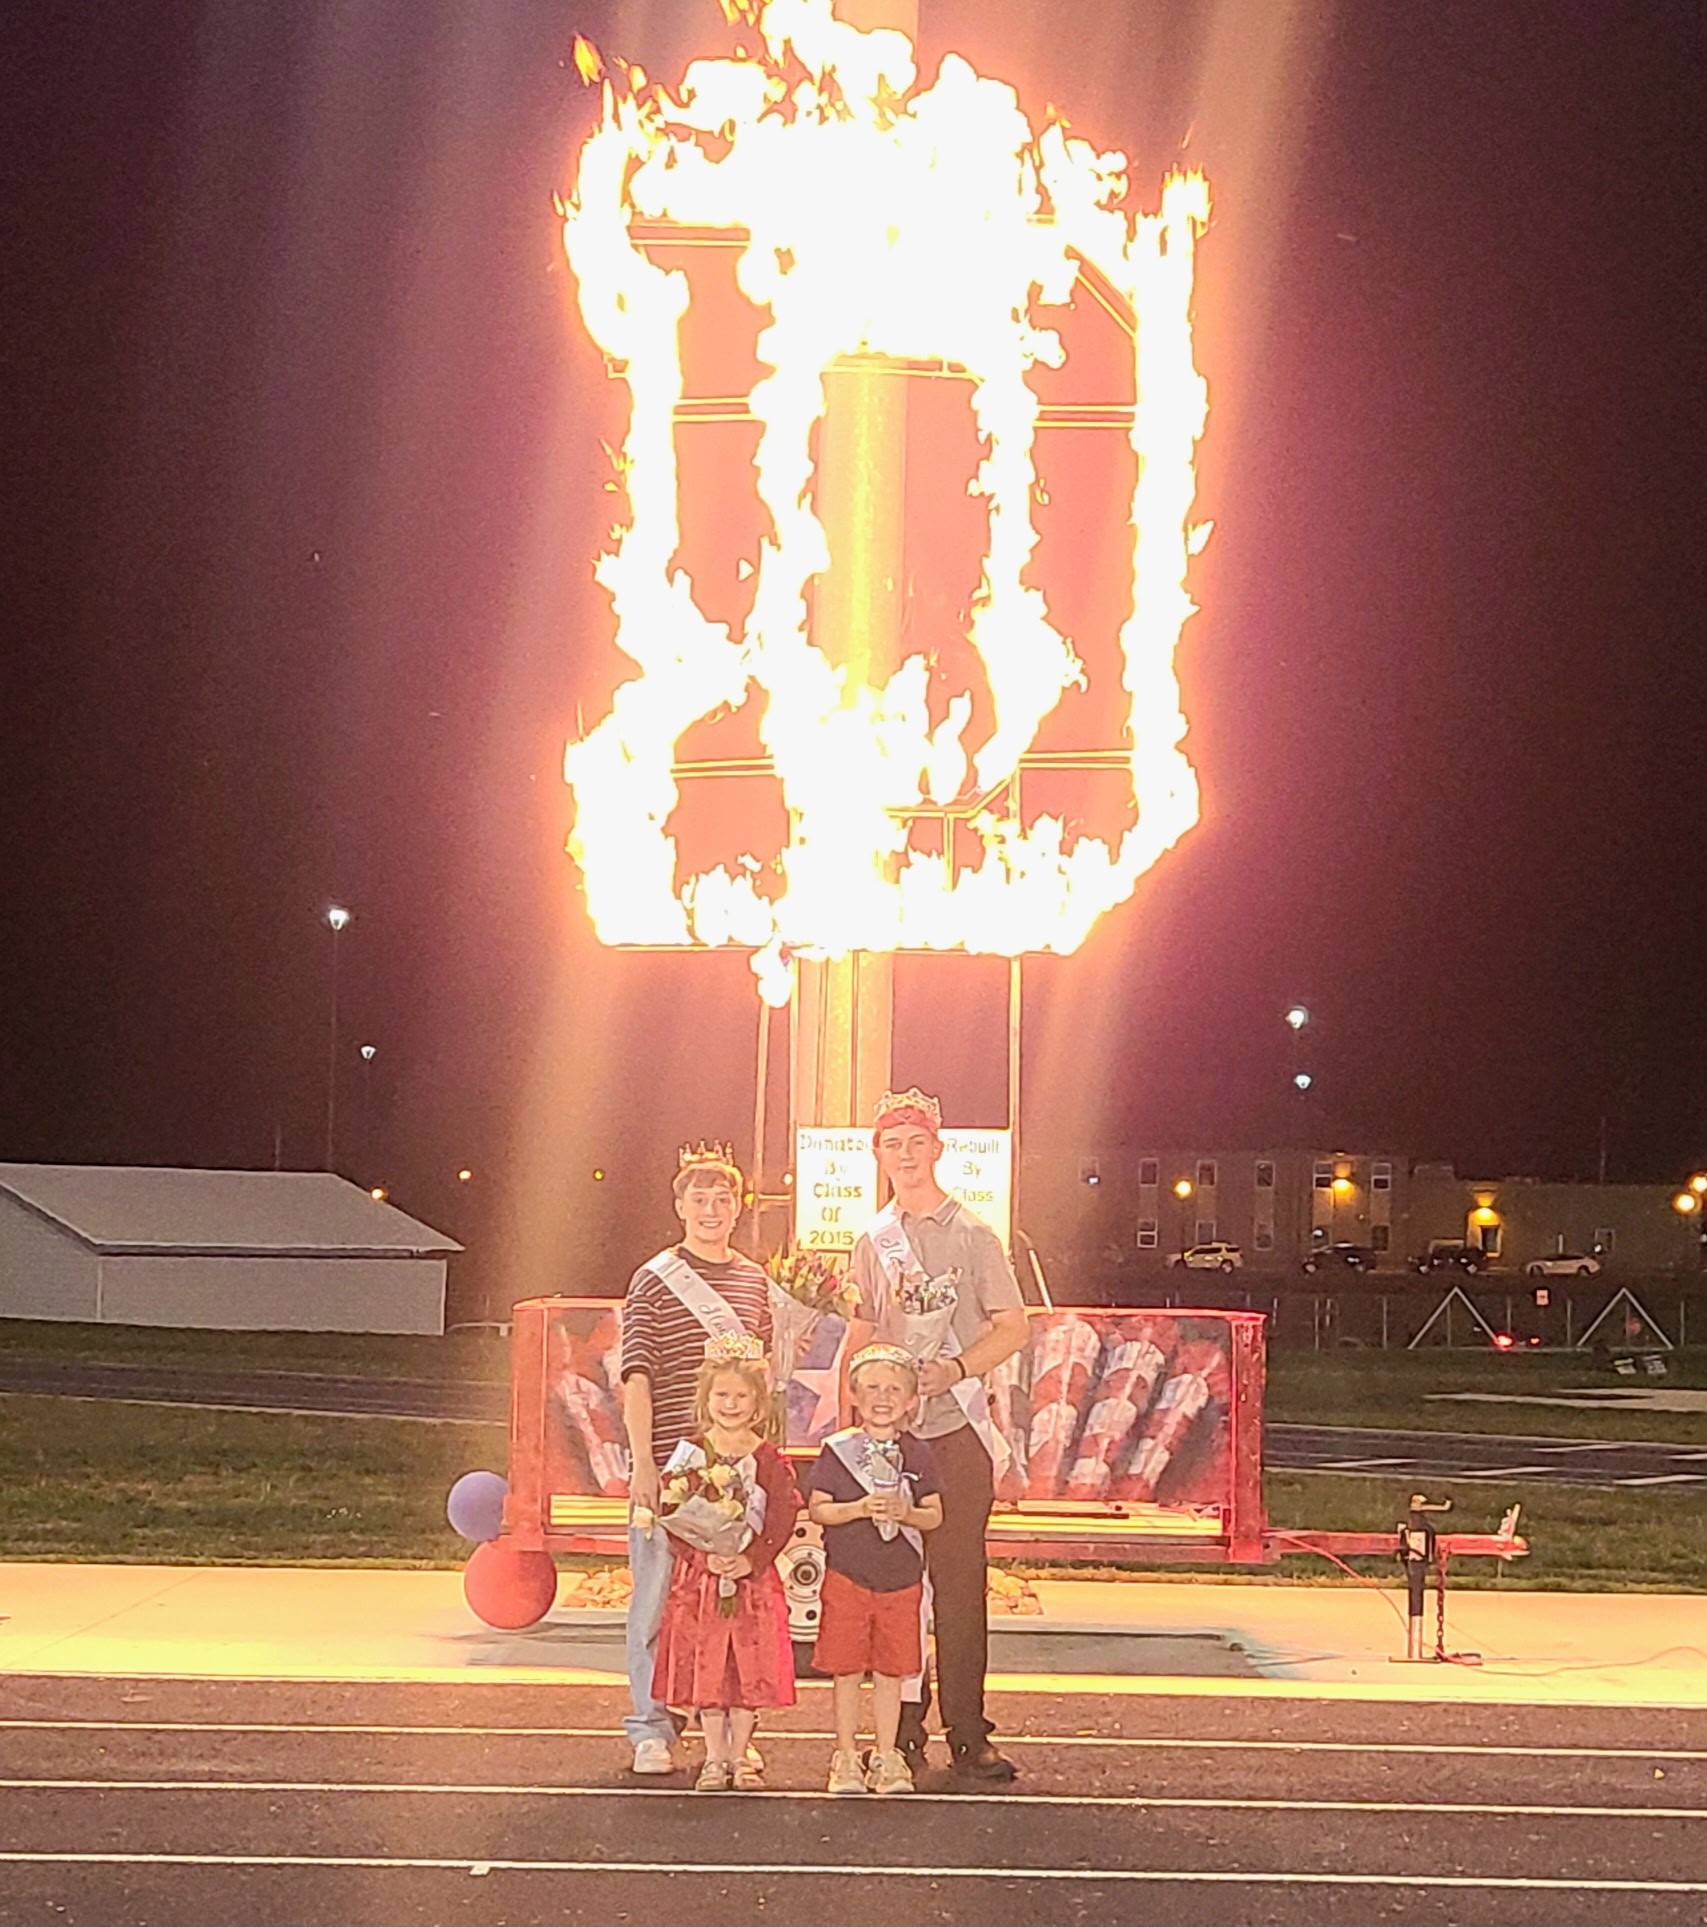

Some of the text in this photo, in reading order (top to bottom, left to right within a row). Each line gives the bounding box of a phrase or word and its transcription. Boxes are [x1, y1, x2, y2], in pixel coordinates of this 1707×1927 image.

[946, 1137, 1000, 1154] Rebuilt
[962, 1160, 981, 1179] By
[813, 1182, 862, 1198] Class
[821, 1206, 842, 1223] Of
[809, 1229, 854, 1246] 2015
